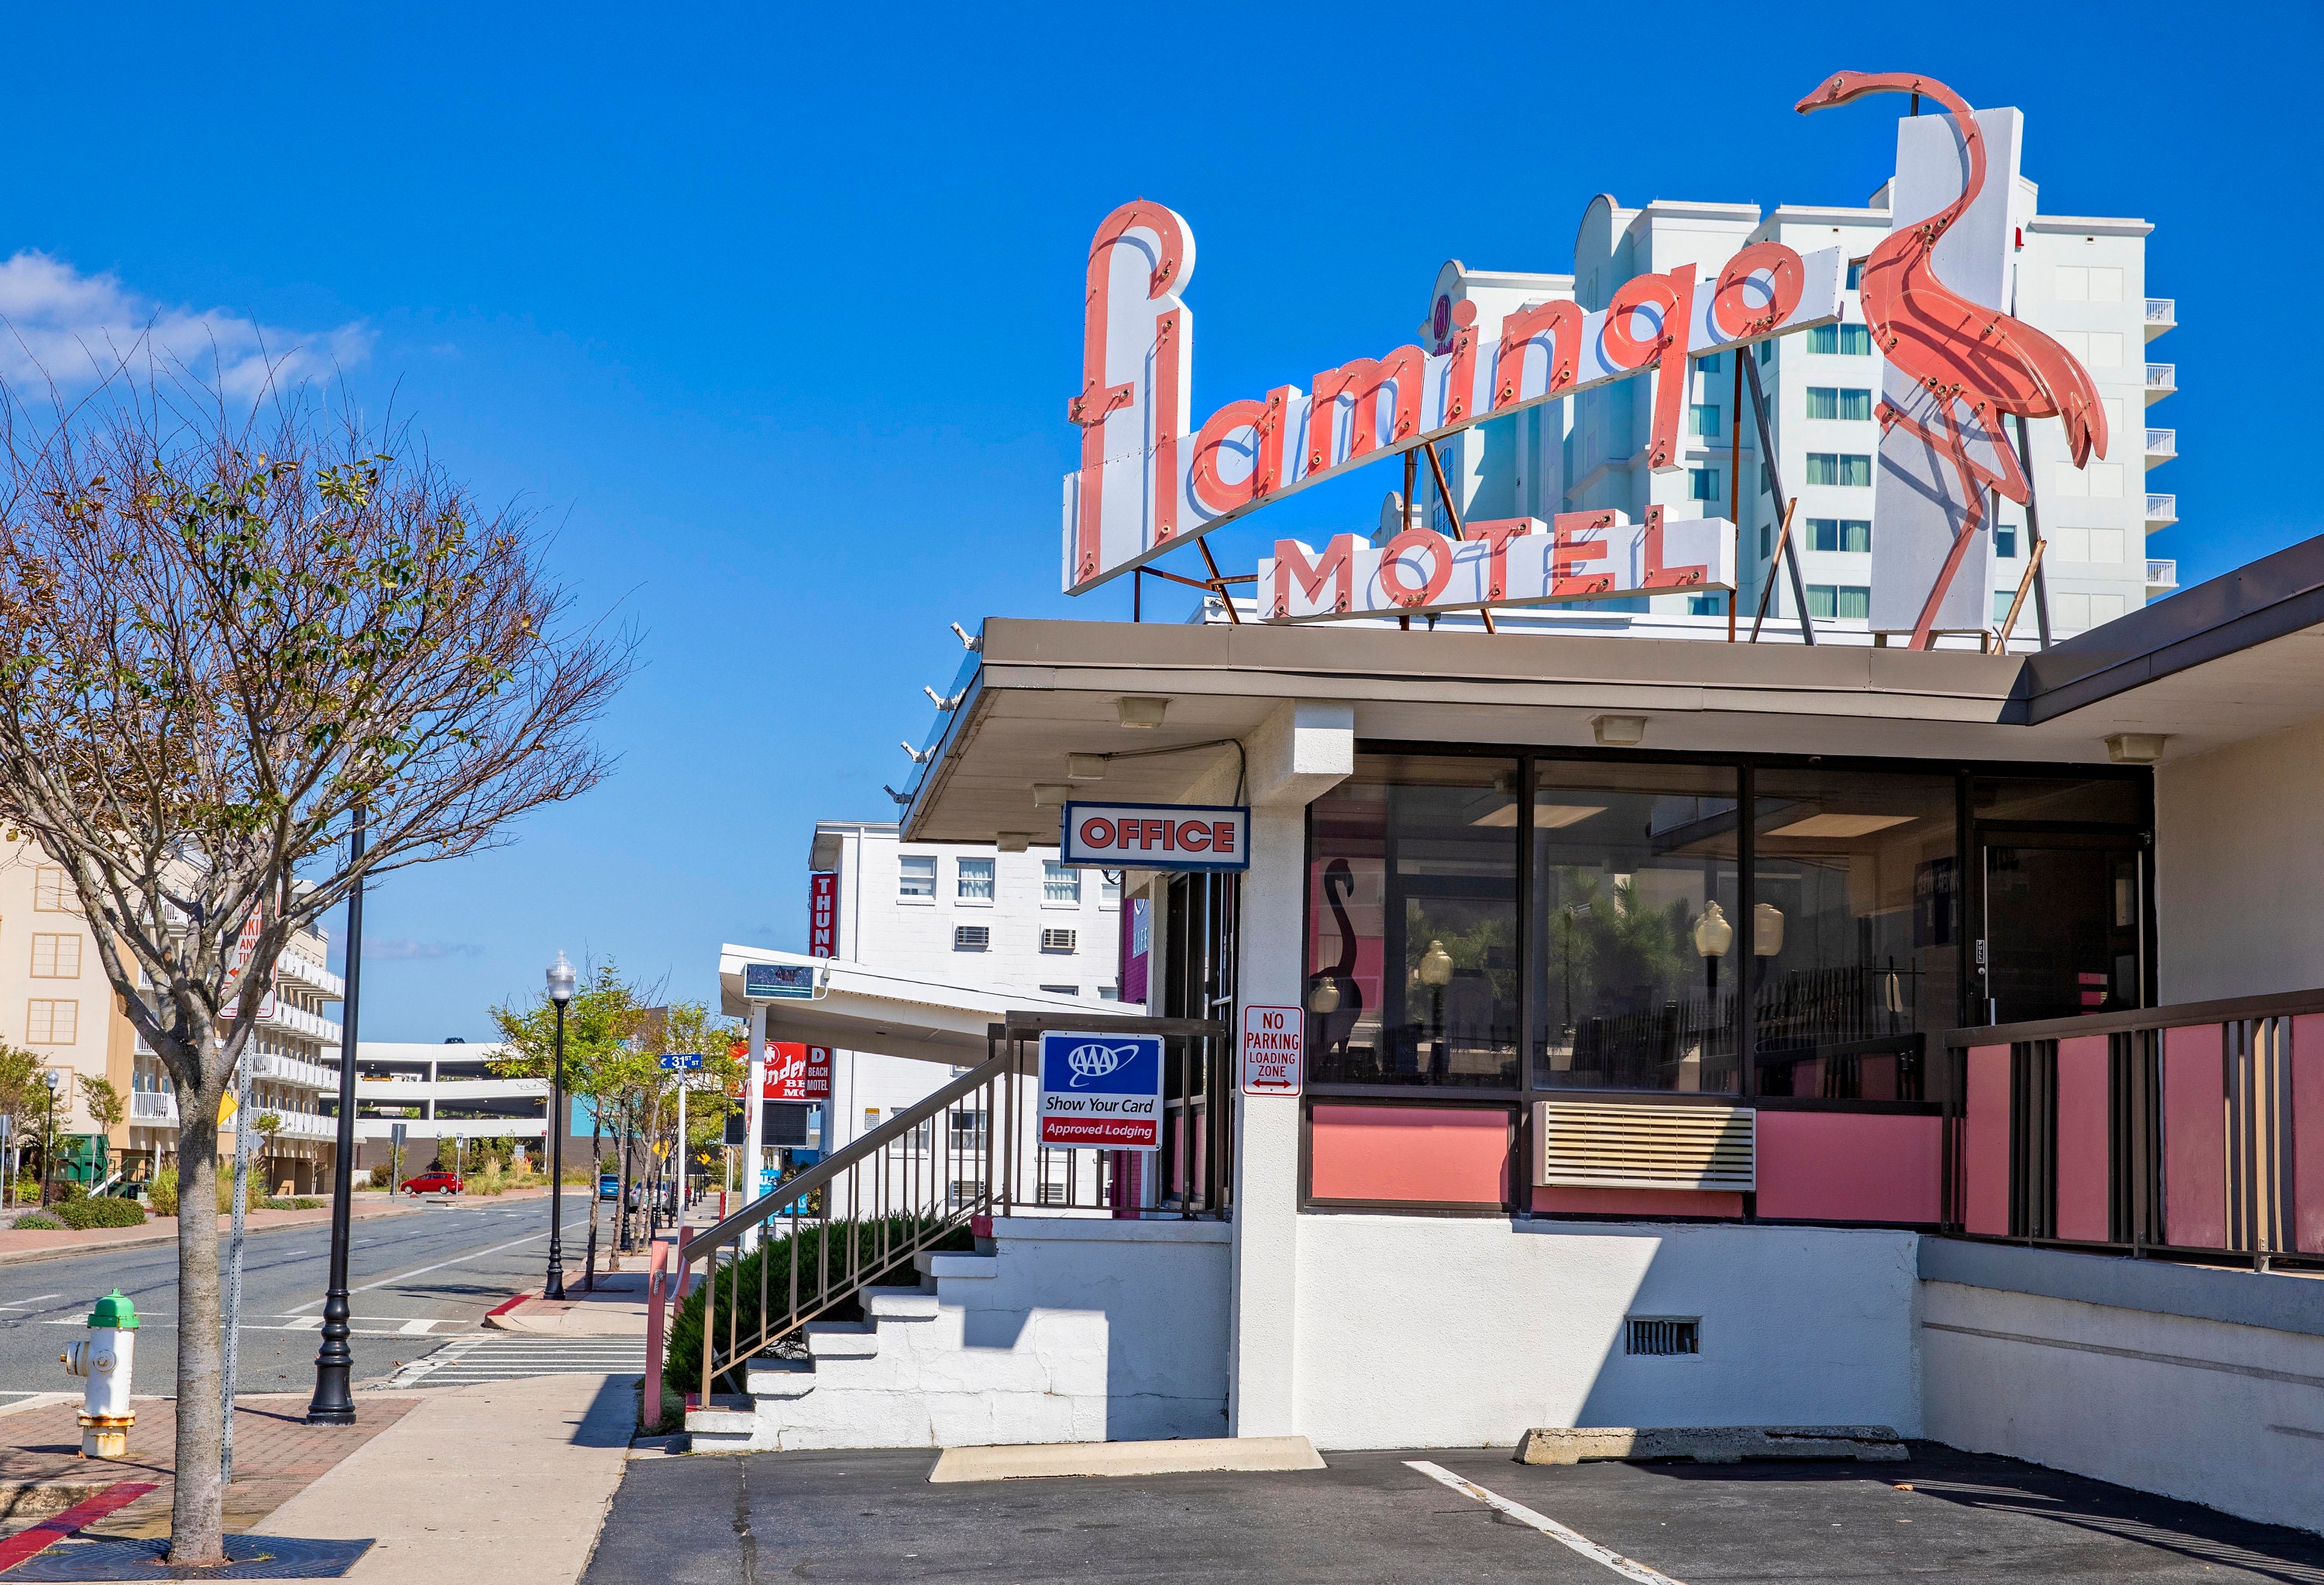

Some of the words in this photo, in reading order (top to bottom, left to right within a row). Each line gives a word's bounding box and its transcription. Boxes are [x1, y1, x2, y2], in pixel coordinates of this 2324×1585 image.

[1273, 504, 1707, 620] MOTEL
[1080, 817, 1234, 852] OFFICE
[1263, 1013, 1284, 1030] NO
[1246, 1032, 1299, 1050] PARKING
[1071, 1044, 1116, 1076] AAA
[1250, 1051, 1295, 1064] LOADING
[808, 1067, 828, 1077] BEACH
[1258, 1065, 1286, 1078] ZONE
[806, 1079, 828, 1091] MOTEL
[1046, 1096, 1085, 1111] Show
[1089, 1098, 1119, 1112] Your
[1122, 1098, 1154, 1113] Card
[1047, 1123, 1103, 1136] Approved
[1105, 1126, 1153, 1139] Lodging
